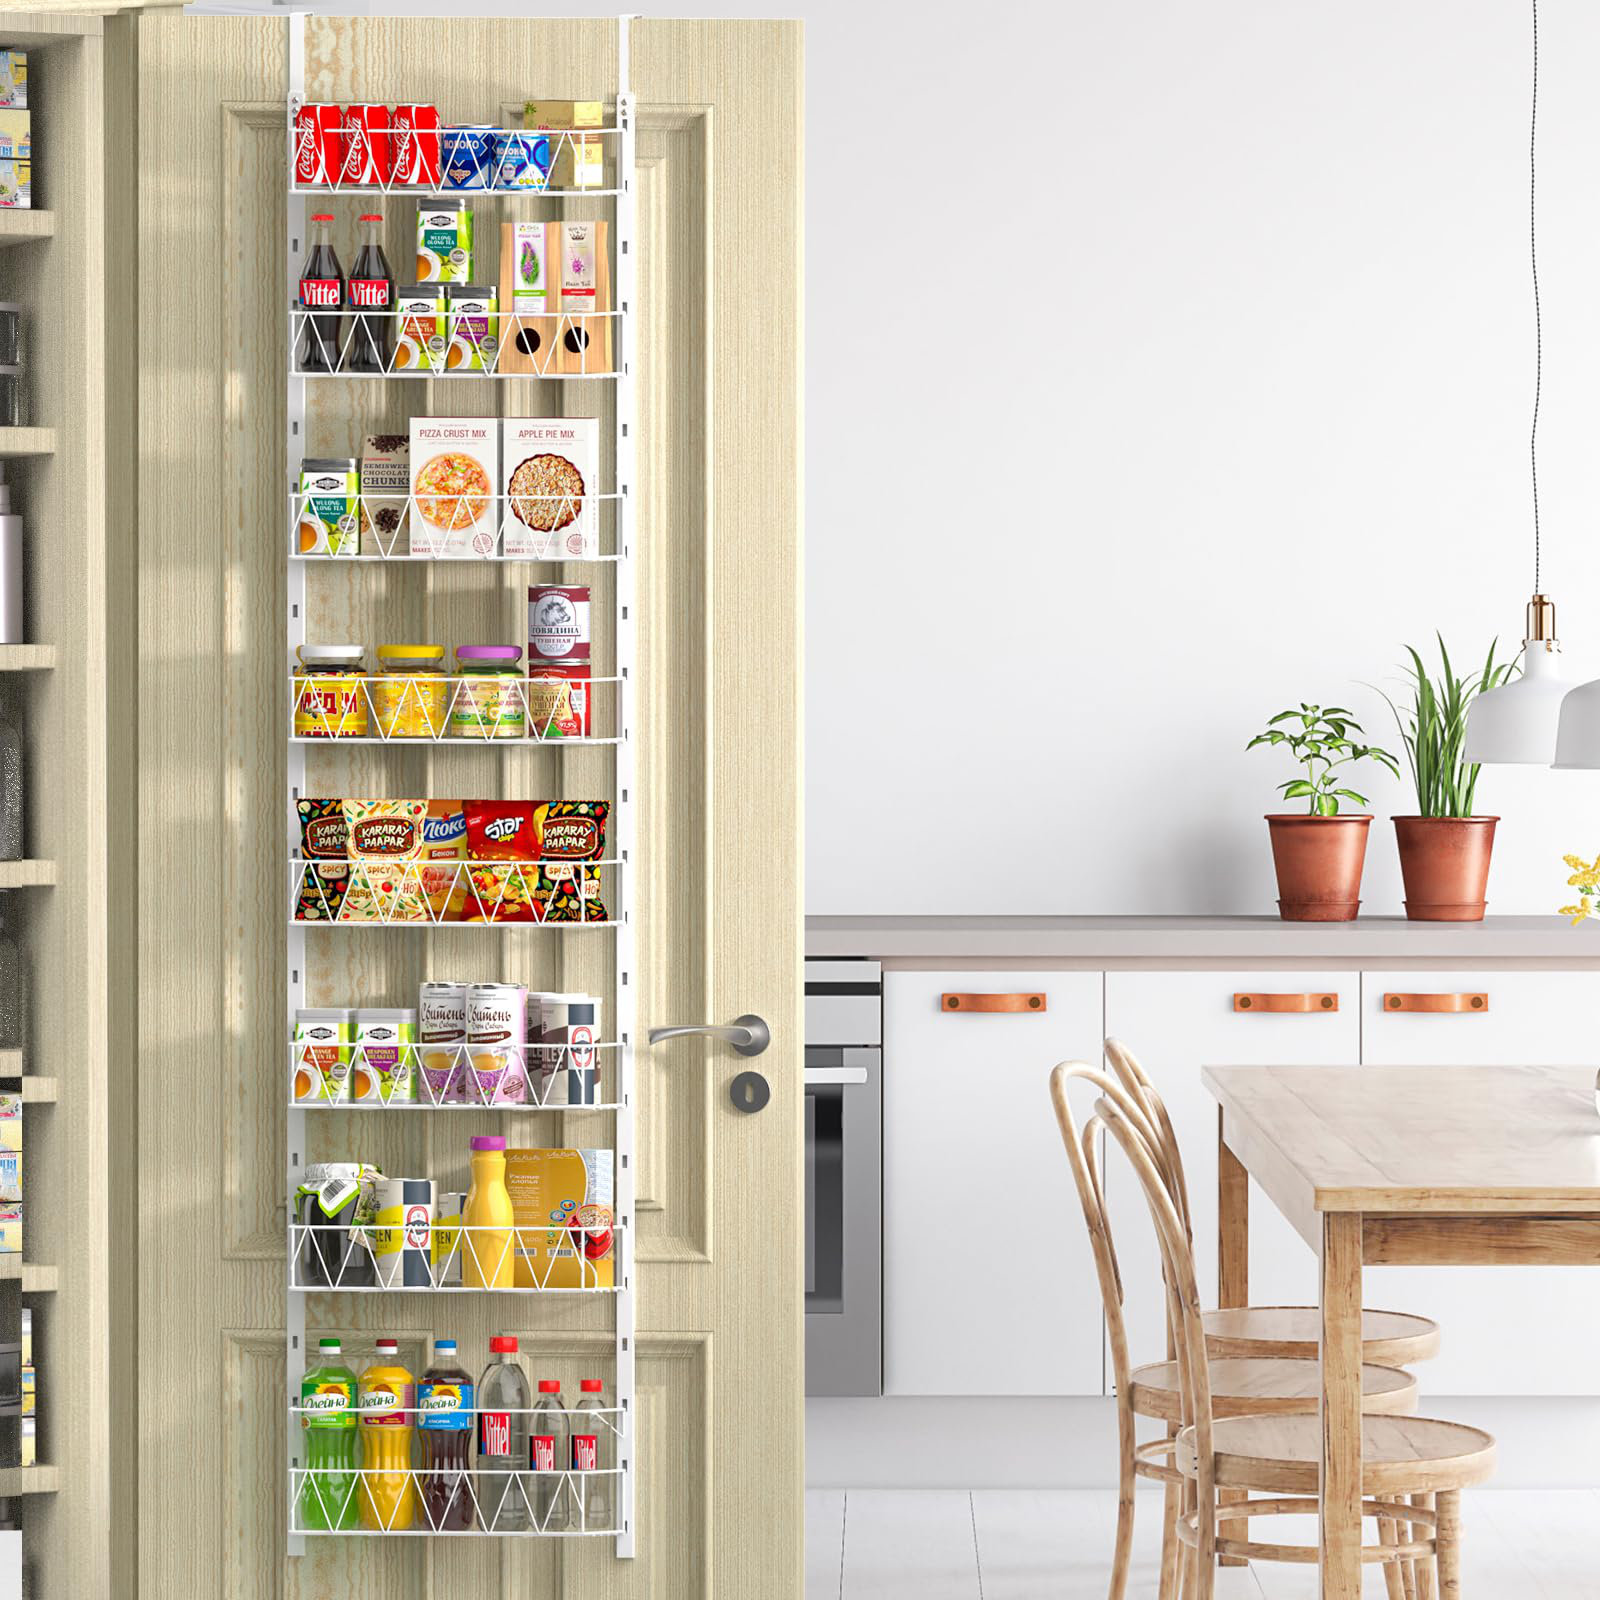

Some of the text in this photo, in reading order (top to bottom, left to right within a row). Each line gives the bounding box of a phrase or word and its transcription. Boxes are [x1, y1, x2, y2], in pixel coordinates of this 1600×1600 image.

[303, 282, 340, 305] Vittel
[351, 282, 389, 305] Vittel
[419, 429, 487, 438] PIZZA CRUST MIX
[518, 430, 575, 438] APPLE PIE MIX
[362, 825, 410, 838] KARARAY
[543, 825, 592, 839] KARARAY
[364, 836, 405, 848] PAAPAR
[546, 837, 587, 849] PAAPAR
[322, 865, 346, 873] SPICY
[367, 865, 391, 874] SPICY
[485, 1414, 511, 1455] Vittel
[535, 1439, 555, 1470] Vittel
[577, 1439, 597, 1470] Vittel
